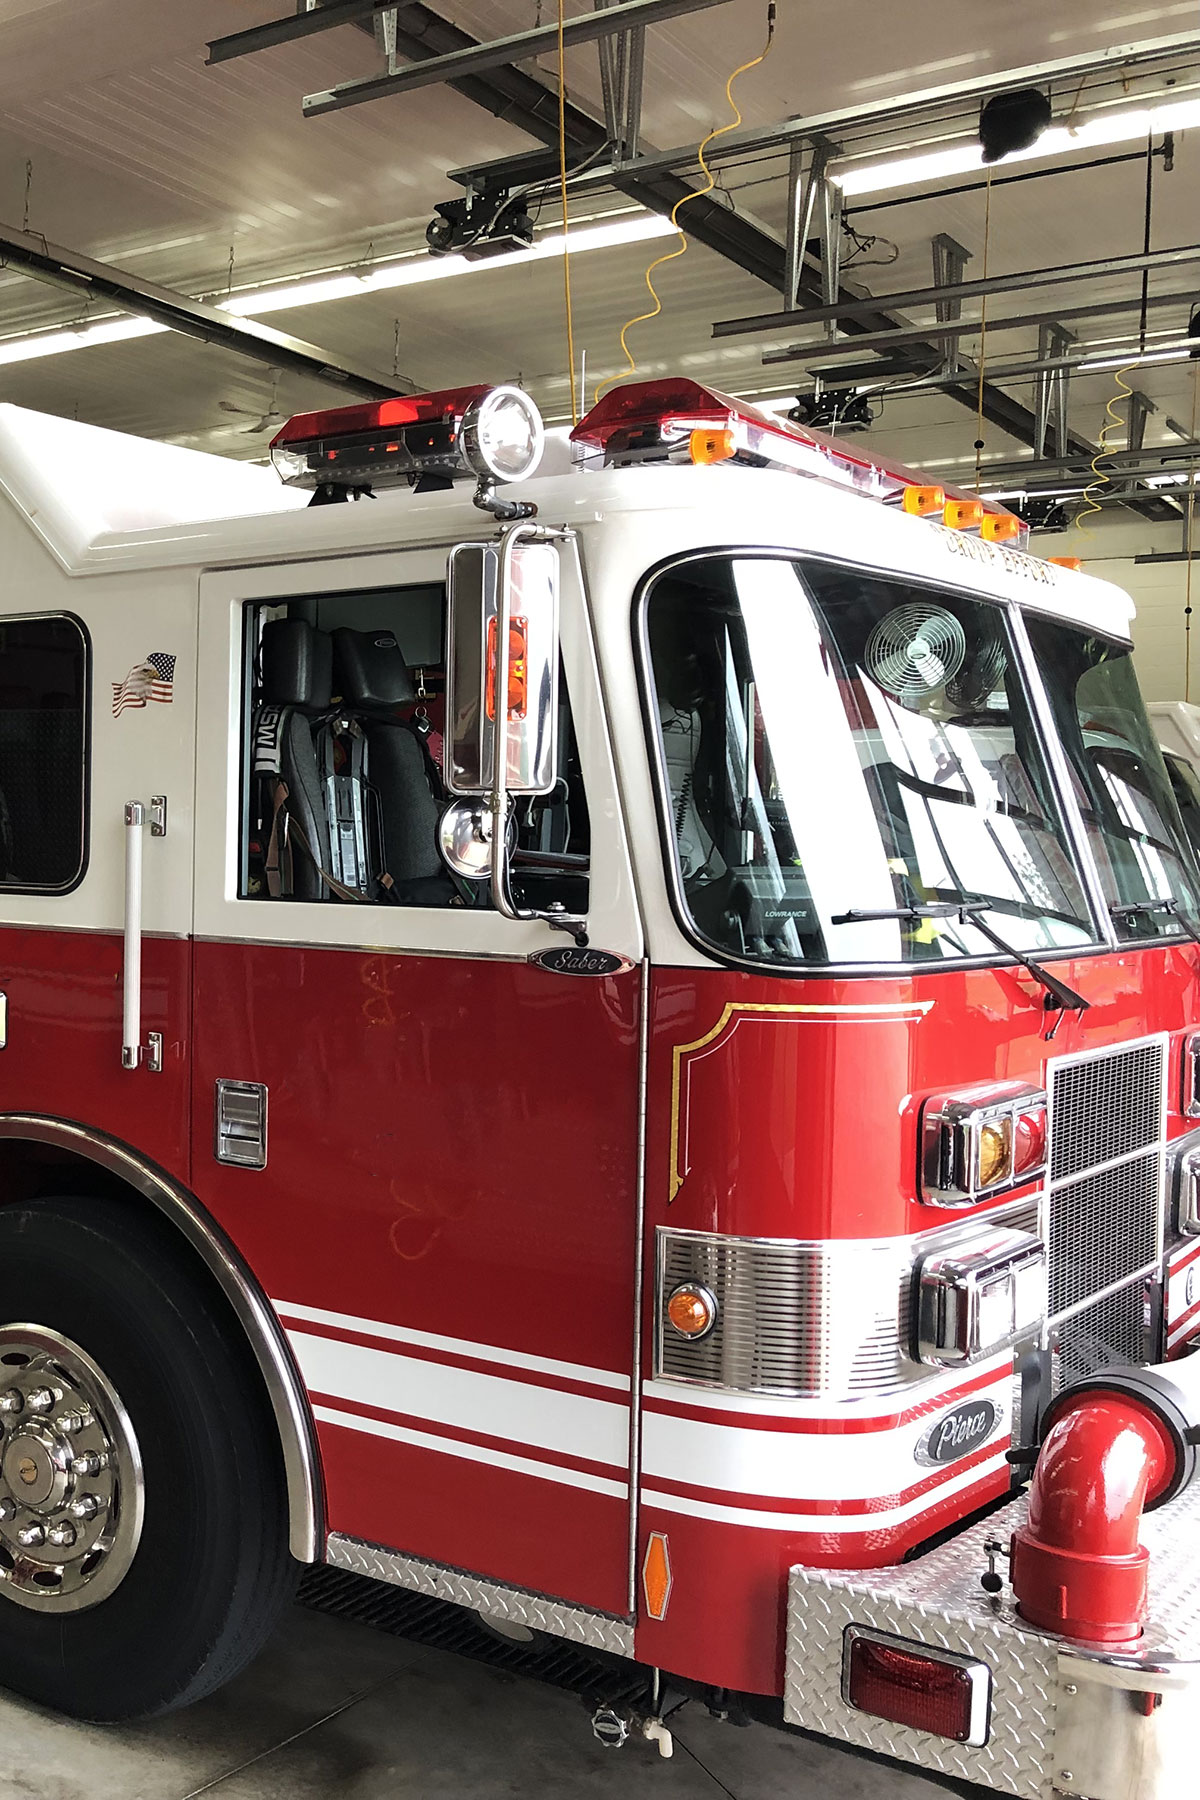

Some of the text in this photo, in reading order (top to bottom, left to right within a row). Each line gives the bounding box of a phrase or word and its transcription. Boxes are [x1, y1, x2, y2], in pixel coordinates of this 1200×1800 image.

[764, 910, 807, 918] LOWRANCE
[554, 950, 608, 970] Saber
[936, 1411, 987, 1460] Pierce
